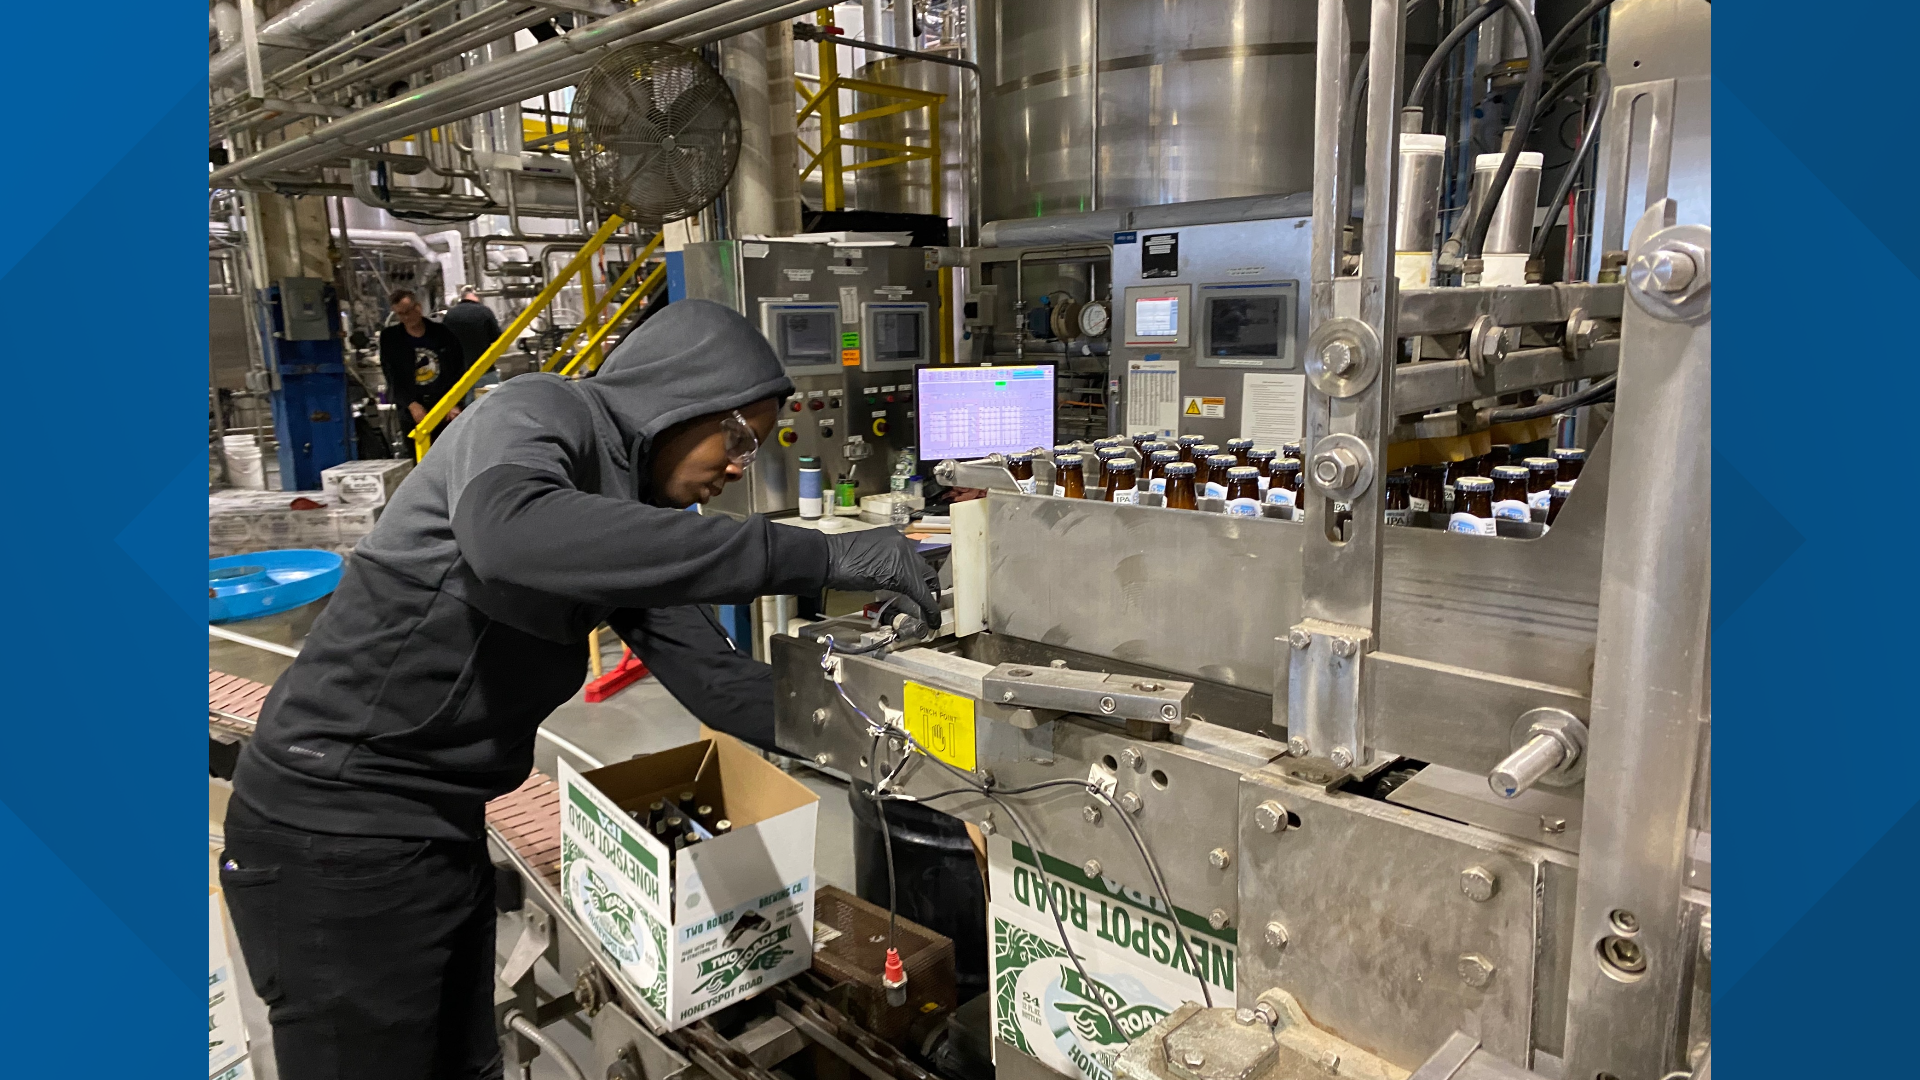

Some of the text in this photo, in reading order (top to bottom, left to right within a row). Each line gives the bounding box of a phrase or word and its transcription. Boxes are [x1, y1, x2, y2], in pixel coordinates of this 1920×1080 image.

[1335, 503, 1346, 511] PA
[1387, 517, 1405, 526] IPA
[919, 705, 957, 723] PINCH POINT
[568, 804, 595, 848] ROAD
[596, 809, 622, 844] IPA
[591, 872, 606, 893] TWO
[598, 831, 660, 905] HONEYSPOT
[604, 894, 629, 915] ROADS
[685, 883, 804, 939] TWO ROADS BREWING CO.
[1013, 866, 1234, 992] NEYSPOT ROAD
[711, 951, 738, 969] TWO
[737, 931, 779, 970] ROADS
[680, 976, 763, 1021] HONEYSPOT ROAD
[1022, 991, 1040, 1008] 24
[1079, 977, 1118, 1010] TWO
[1067, 1043, 1113, 1080] HONE
